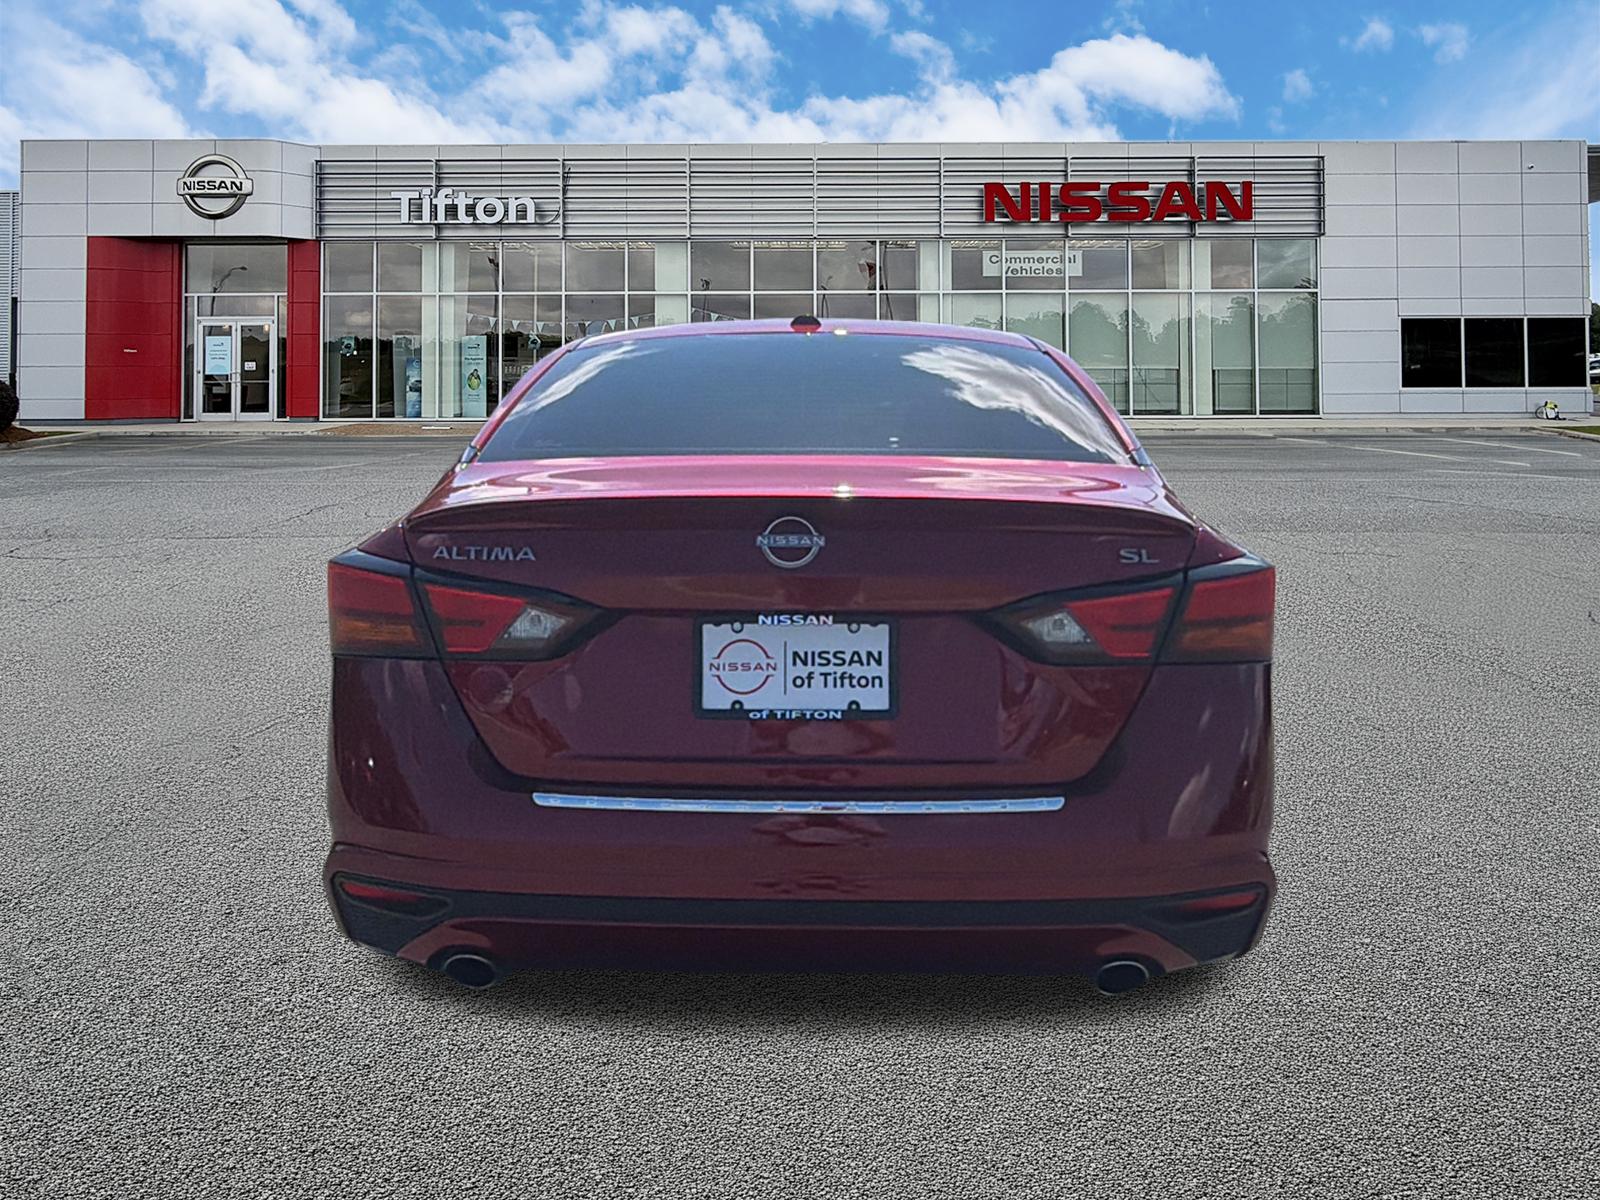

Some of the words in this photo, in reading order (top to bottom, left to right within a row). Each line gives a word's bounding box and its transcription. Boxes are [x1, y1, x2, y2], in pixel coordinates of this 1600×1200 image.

[182, 180, 243, 192] NISSAN
[391, 188, 536, 224] Tifton
[983, 180, 1254, 223] NISSAN
[756, 535, 826, 547] NISSAN
[432, 545, 537, 561] ALTIMA
[1119, 548, 1160, 564] SL
[758, 614, 834, 625] NISSAN
[791, 650, 883, 667] NISSAN
[709, 662, 777, 672] NISSAN
[791, 671, 815, 689] of
[819, 672, 884, 689] Tifton
[748, 710, 769, 720] of
[772, 710, 843, 720] TIFTON
